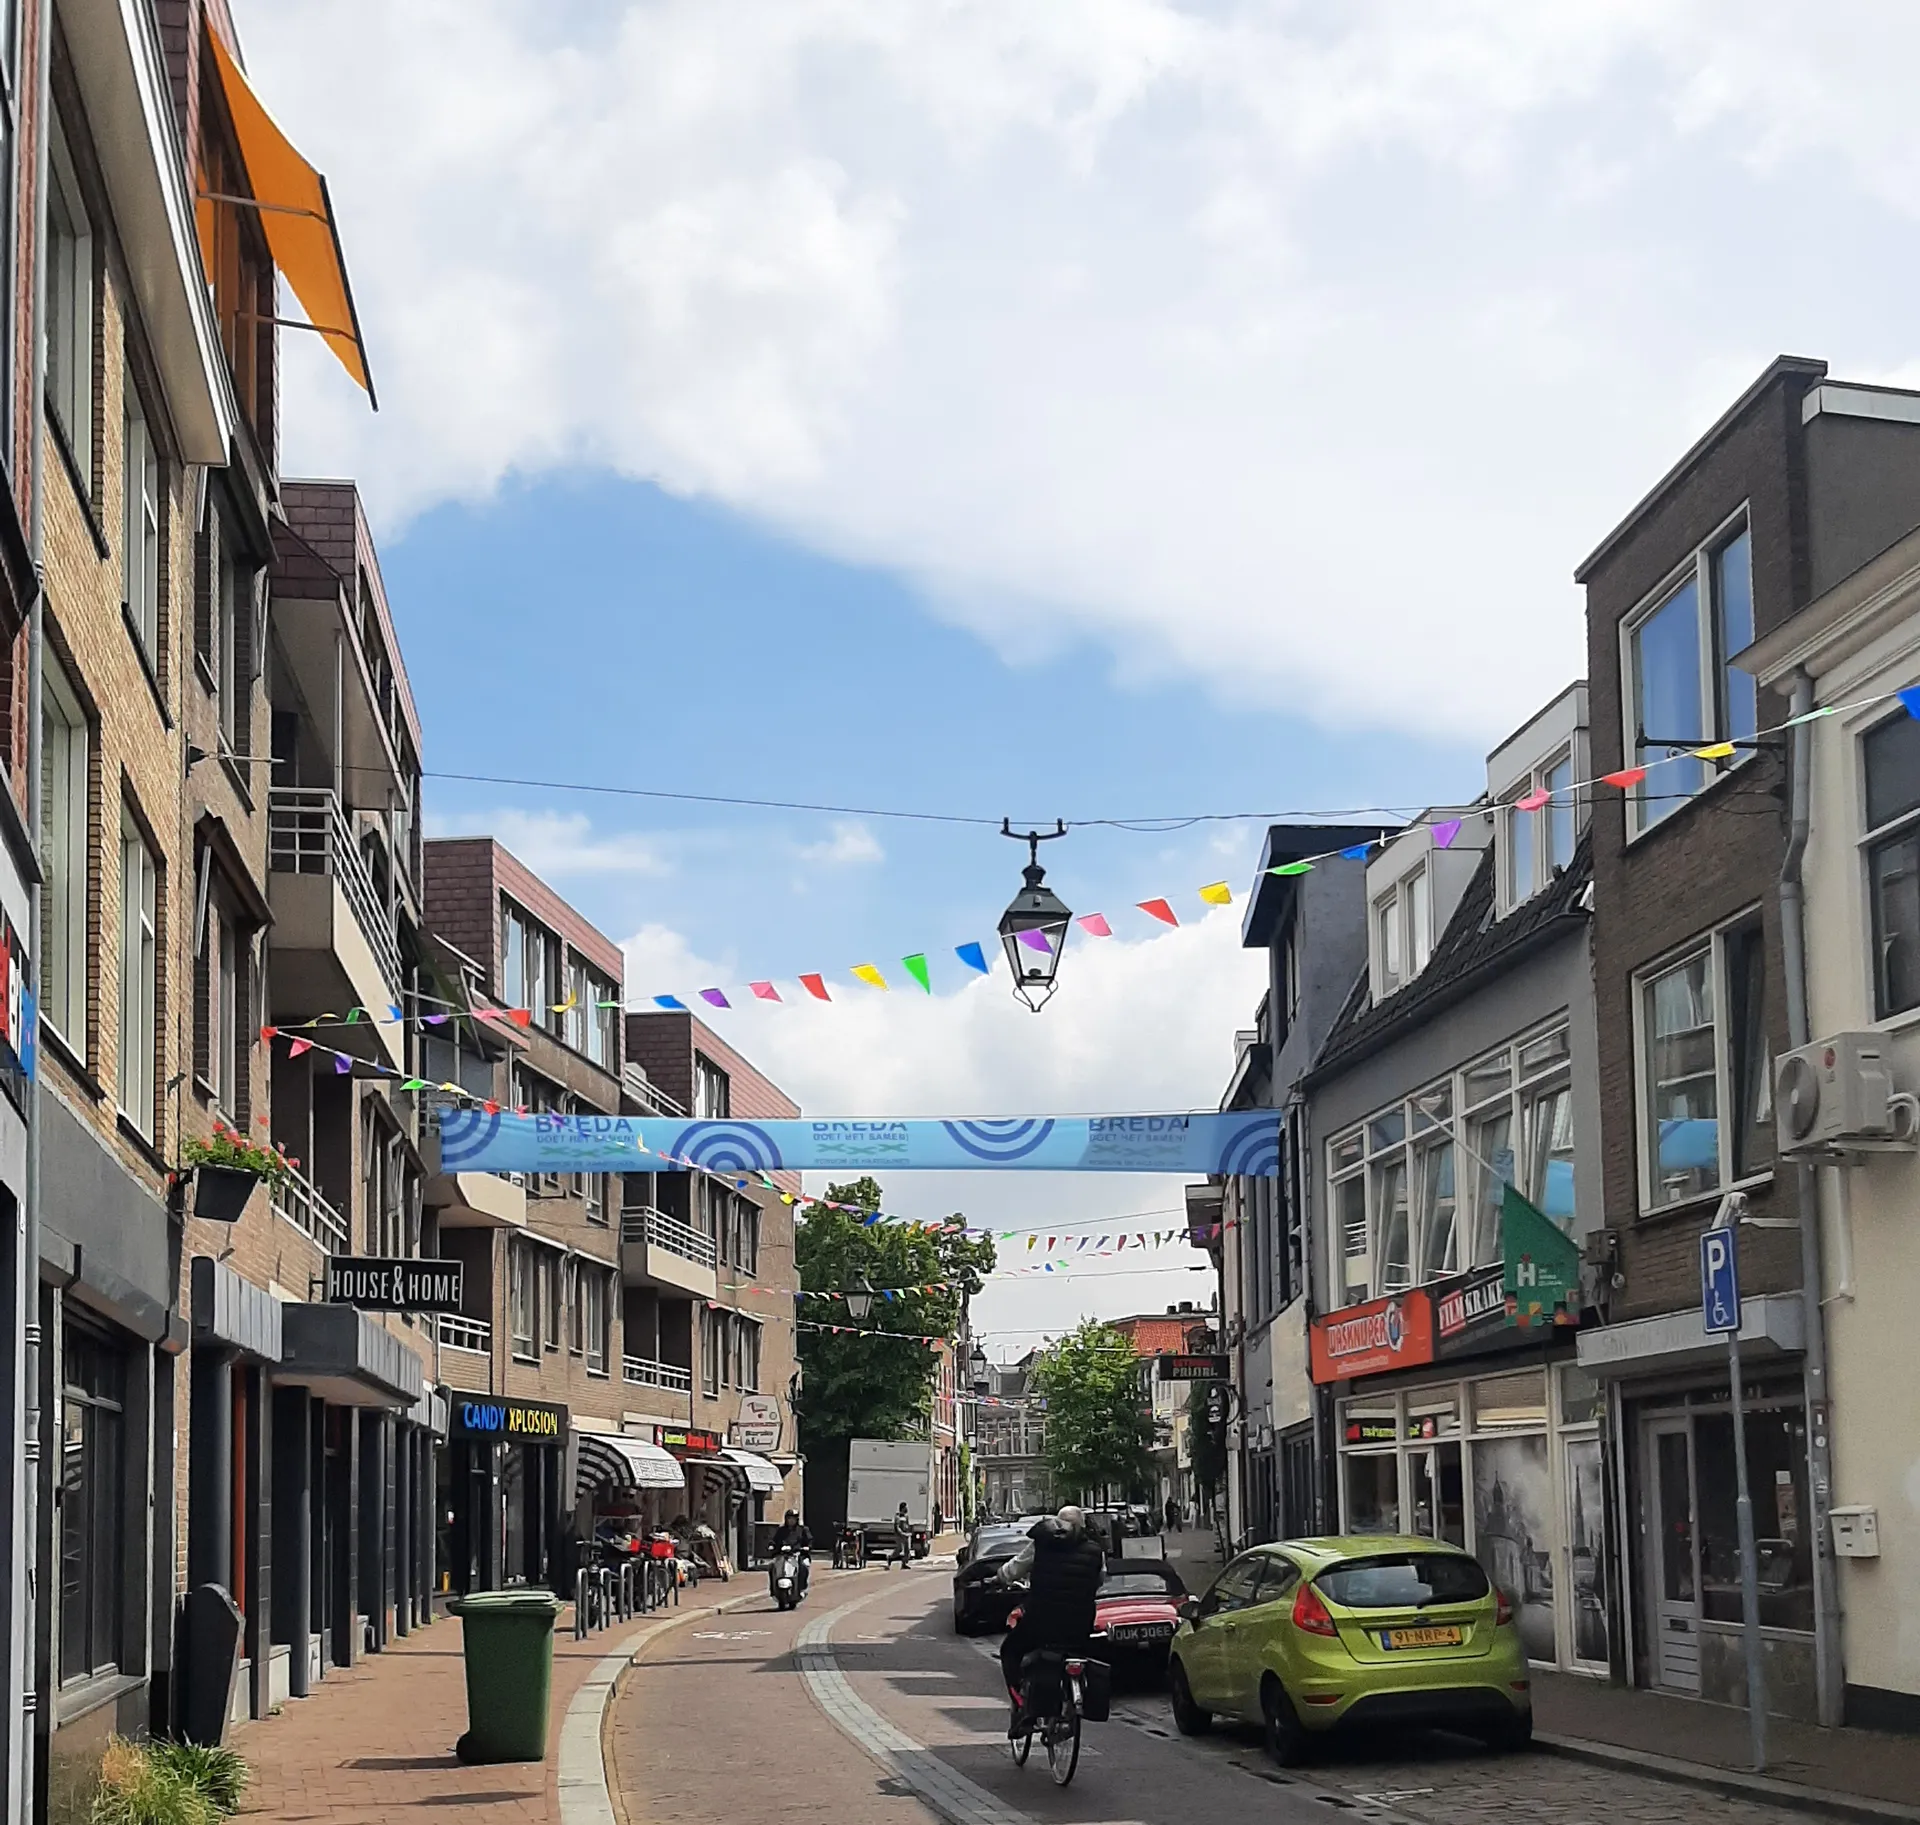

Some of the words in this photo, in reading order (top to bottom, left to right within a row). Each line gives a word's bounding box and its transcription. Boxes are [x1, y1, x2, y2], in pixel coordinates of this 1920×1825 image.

[535, 1115, 634, 1133] BREDA
[1088, 1116, 1186, 1132] BREDA
[1707, 1239, 1726, 1290] P
[1438, 1295, 1465, 1331] FILM
[463, 1402, 506, 1431] CANDY
[508, 1407, 558, 1435] XPLOSION
